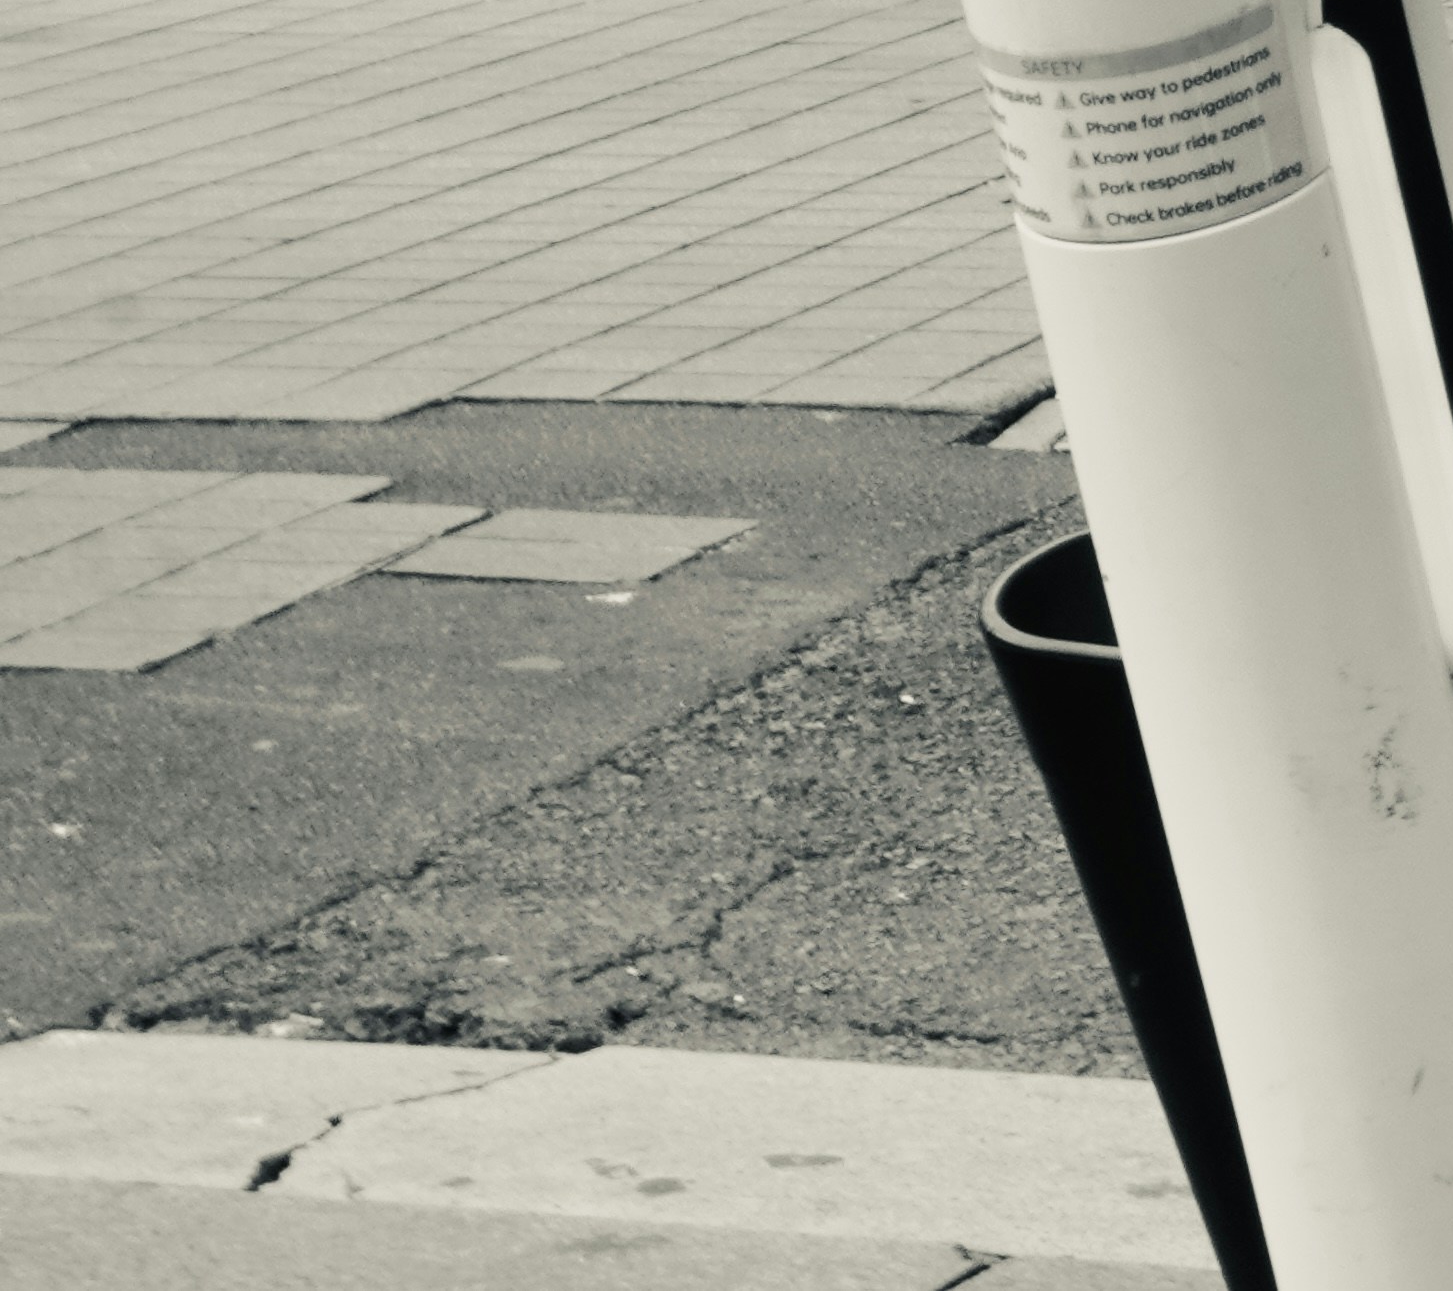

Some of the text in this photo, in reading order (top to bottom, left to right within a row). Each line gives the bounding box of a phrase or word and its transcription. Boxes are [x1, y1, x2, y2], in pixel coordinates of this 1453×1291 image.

[1021, 59, 1084, 77] SAFETY
[1079, 45, 1271, 108] Give way to pedestrians
[1085, 71, 1282, 137] Phone for navigation only
[1093, 113, 1266, 167] Know your ride zones
[1099, 157, 1237, 197] Park responsibly
[1105, 159, 1304, 228] Check brakes before riding
